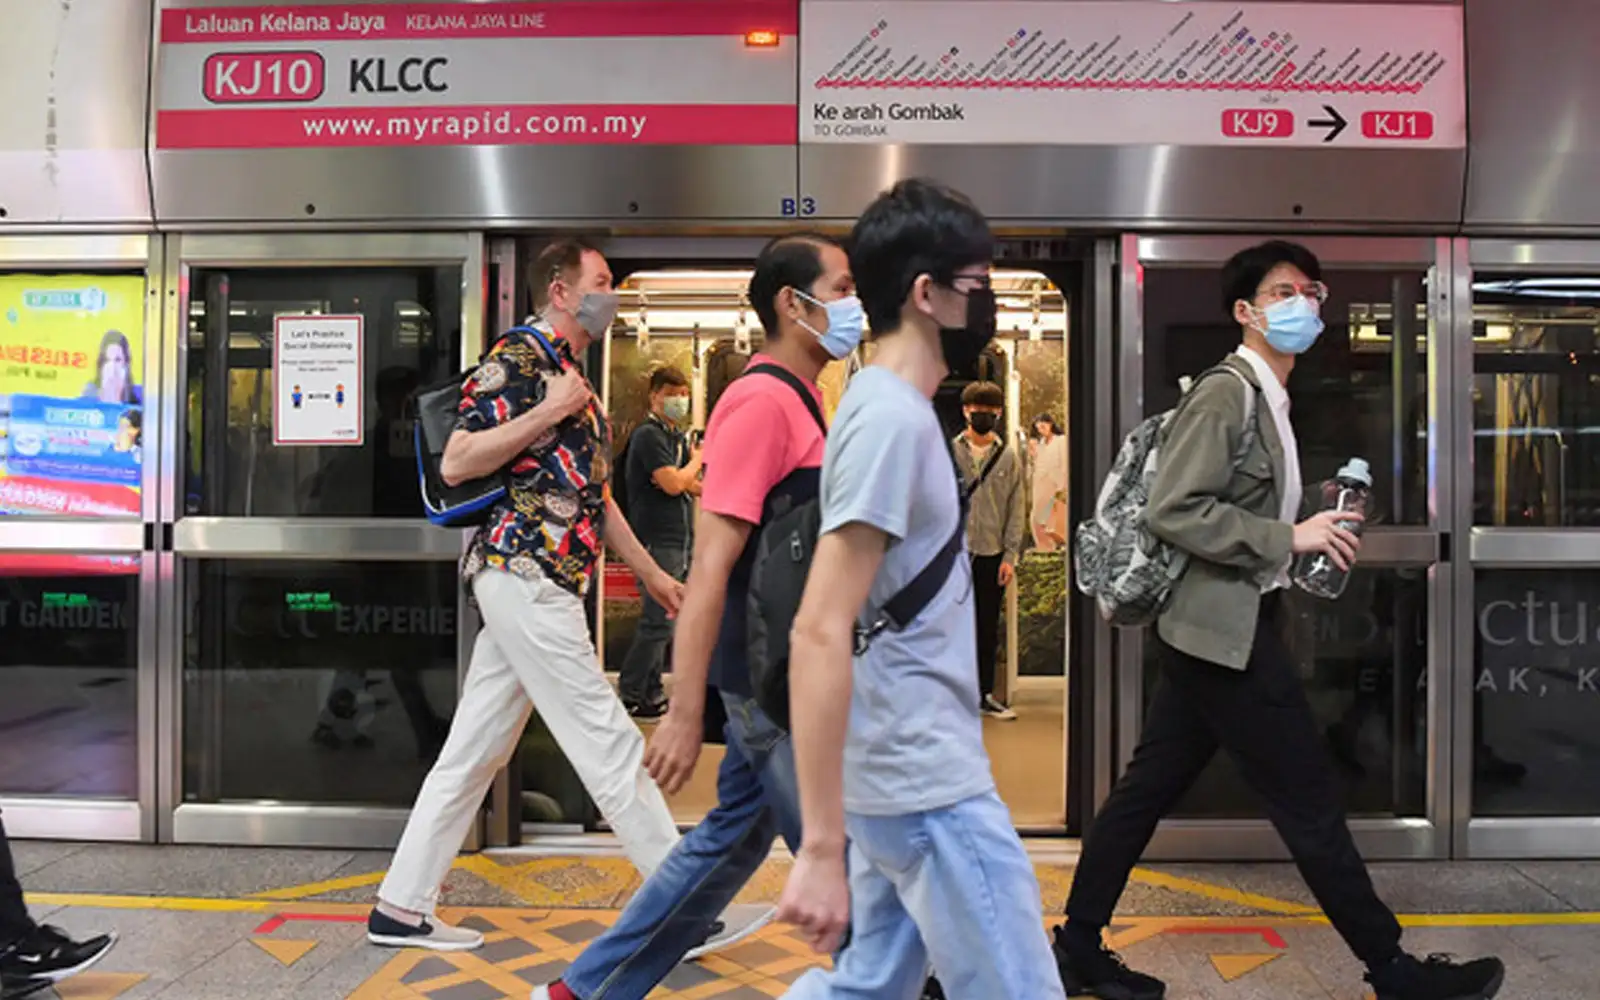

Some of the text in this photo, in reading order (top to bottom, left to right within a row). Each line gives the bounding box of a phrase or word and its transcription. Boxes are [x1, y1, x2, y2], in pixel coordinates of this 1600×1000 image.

[185, 12, 385, 35] Laluan Kelana Jaya
[405, 14, 546, 30] KELANA JAYA LINE
[215, 57, 449, 95] KJ10 KLCC
[813, 102, 964, 120] Ke arah Gombak
[303, 111, 648, 140] www.myrapid.com.my
[813, 124, 888, 136] TO GOMBAK
[1233, 112, 1417, 136] KJ9 KJ1
[782, 198, 816, 215] B 3
[335, 604, 454, 635] EXPERIE
[1479, 590, 1600, 646] ctu
